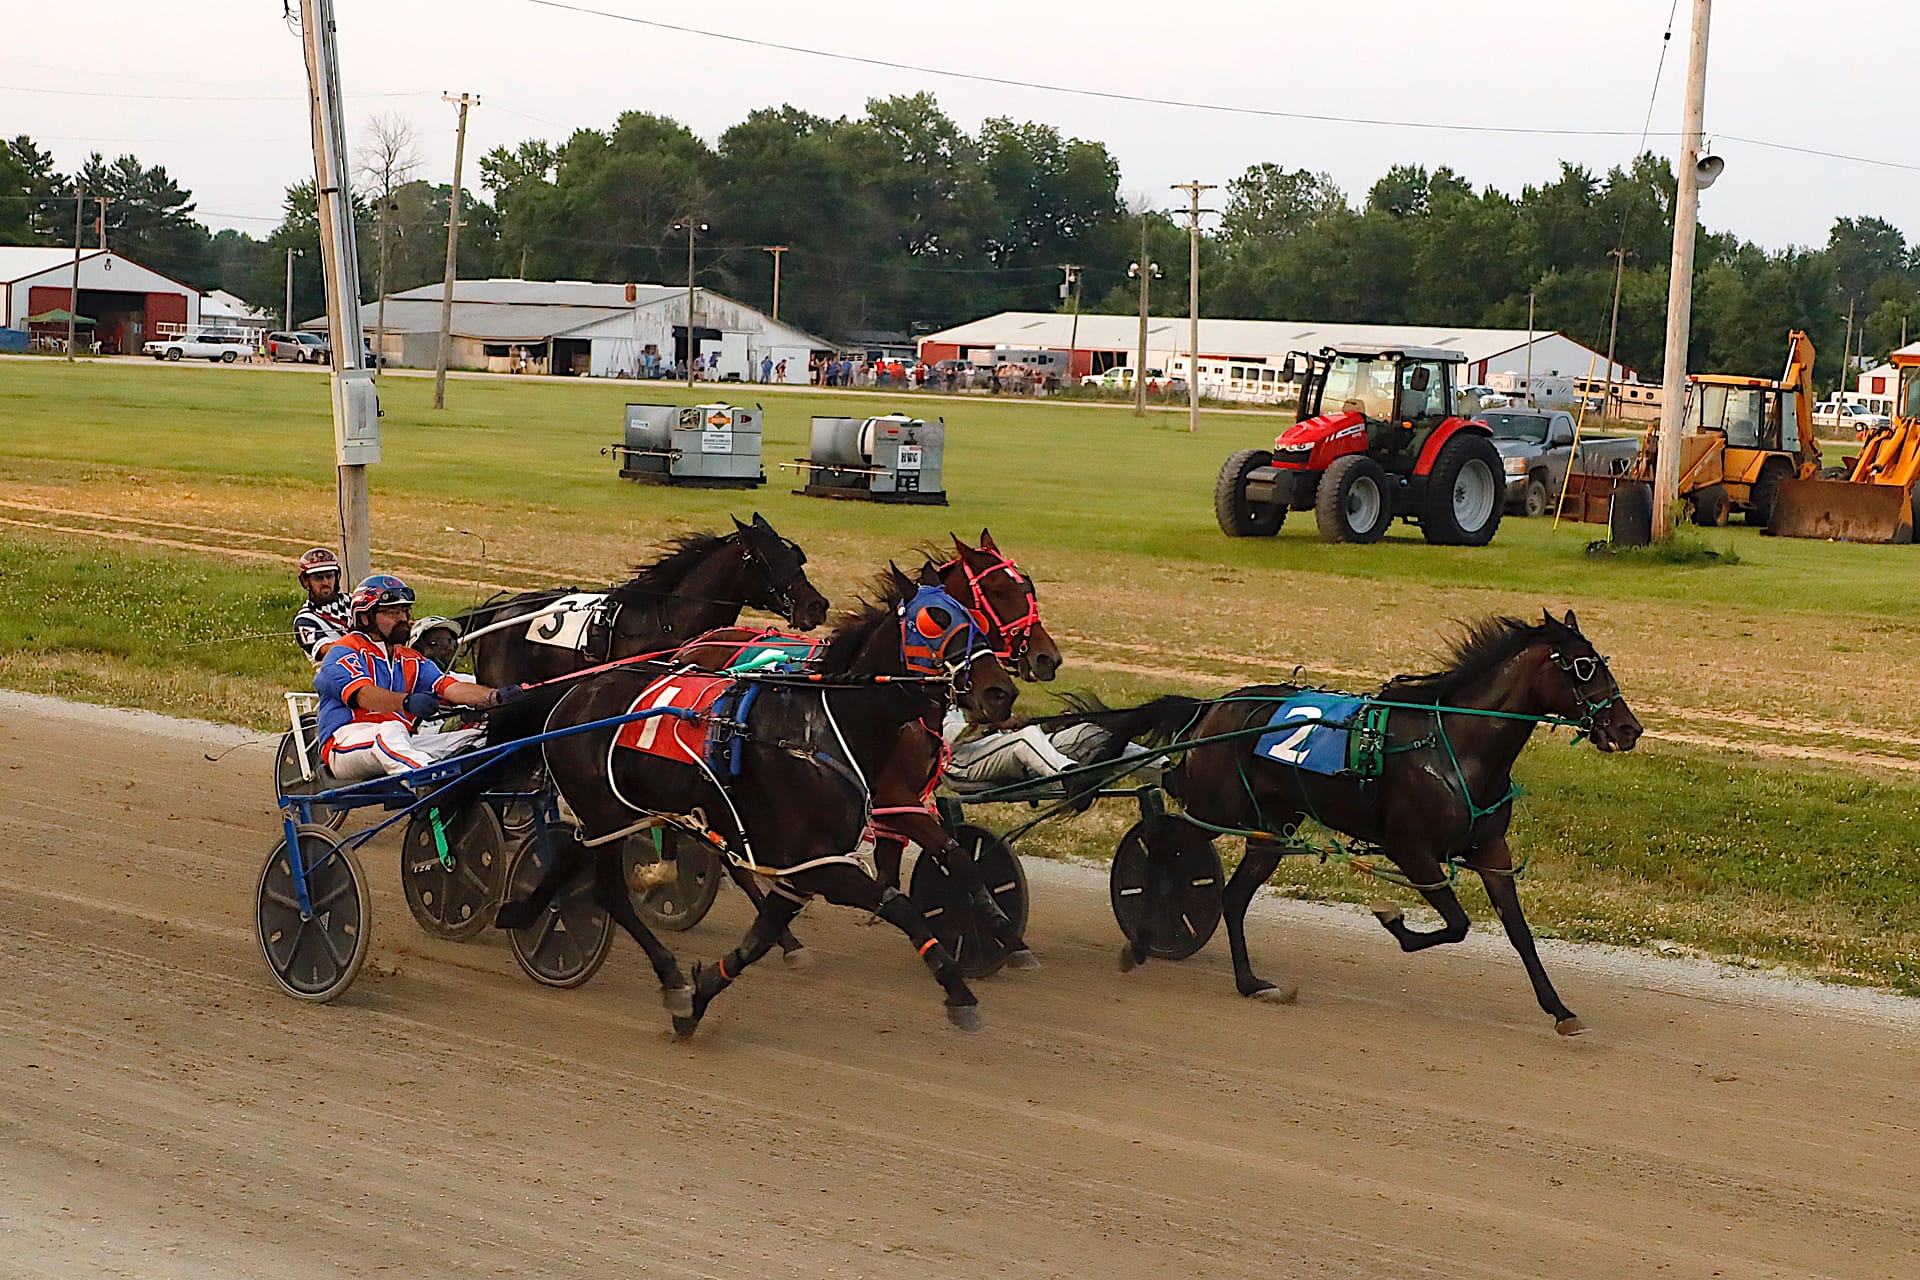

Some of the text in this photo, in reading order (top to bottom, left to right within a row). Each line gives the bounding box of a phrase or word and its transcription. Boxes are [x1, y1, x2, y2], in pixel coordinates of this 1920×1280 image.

[336, 652, 363, 679] F
[635, 686, 682, 750] 1
[1268, 706, 1322, 764] 2
